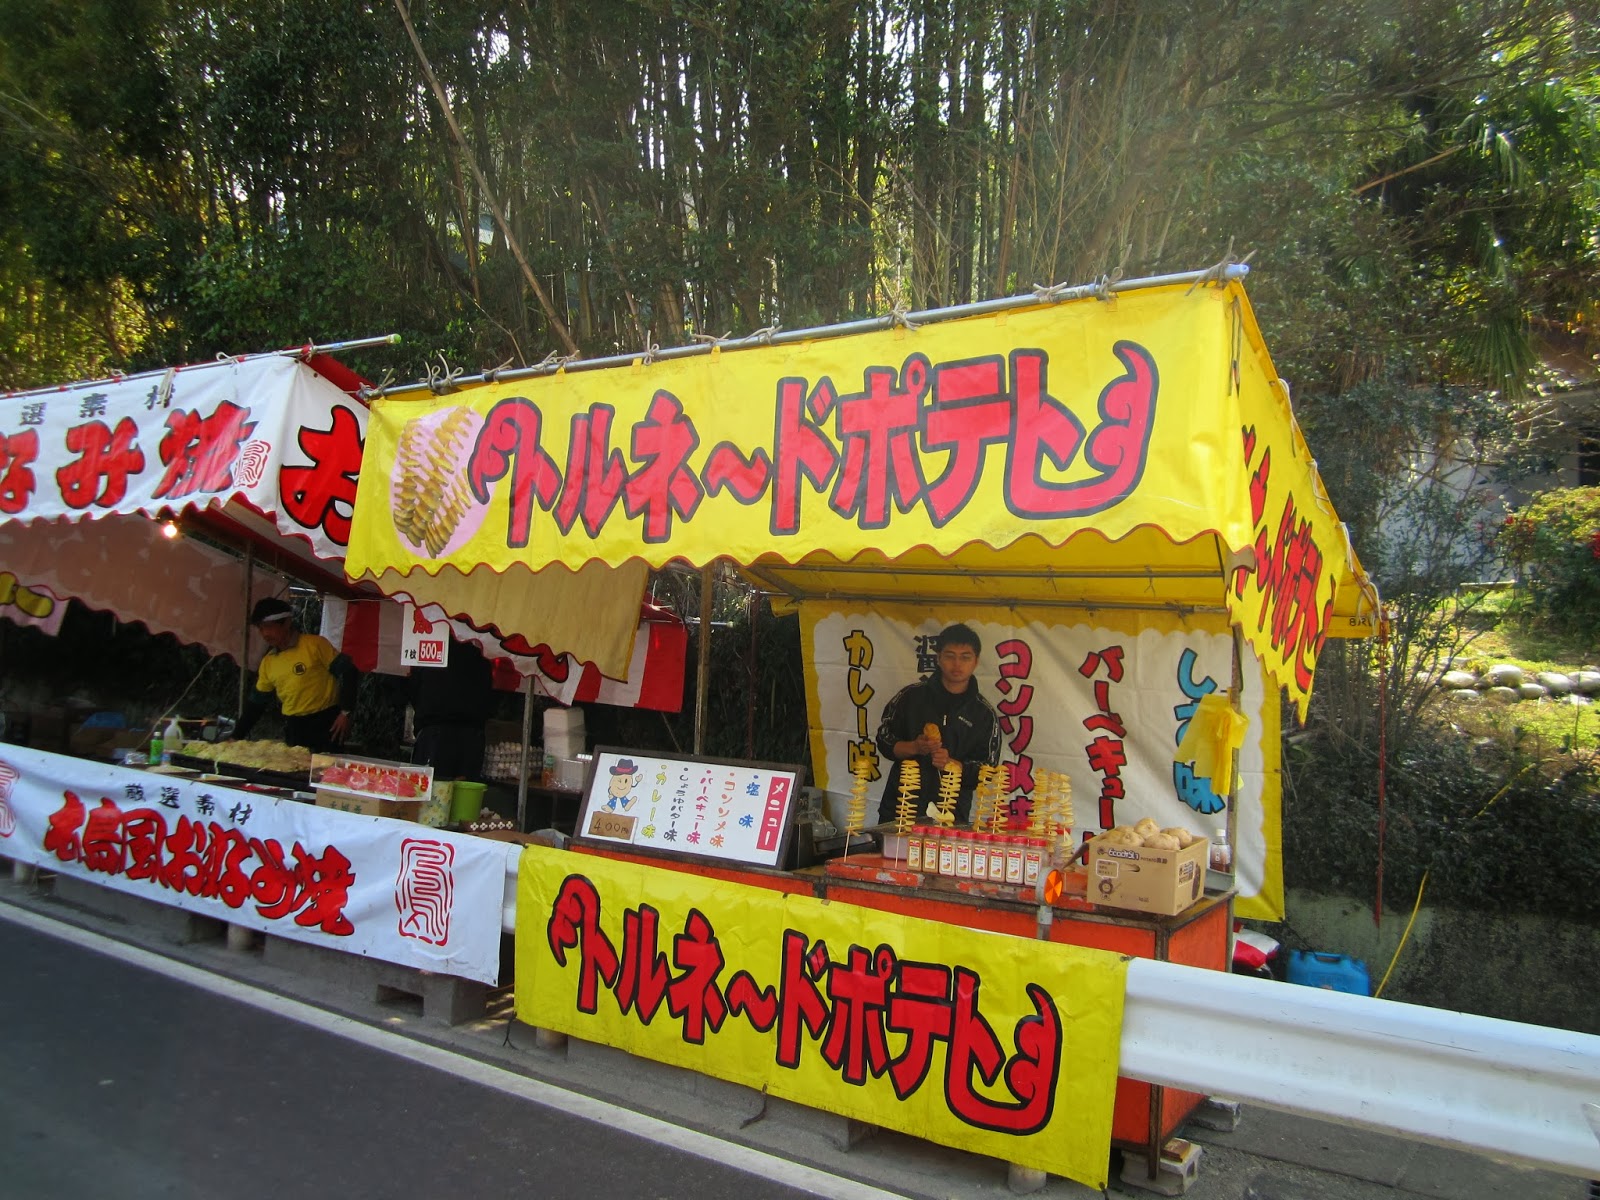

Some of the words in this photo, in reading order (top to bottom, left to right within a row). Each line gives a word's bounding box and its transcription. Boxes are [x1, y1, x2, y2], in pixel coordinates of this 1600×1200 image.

[420, 642, 443, 661] 500円
[843, 629, 881, 782] カレー味
[1078, 645, 1128, 864] バーベキュー
[124, 782, 253, 826] 厳選素材
[593, 817, 630, 835] 400円
[764, 780, 788, 847] メニュー
